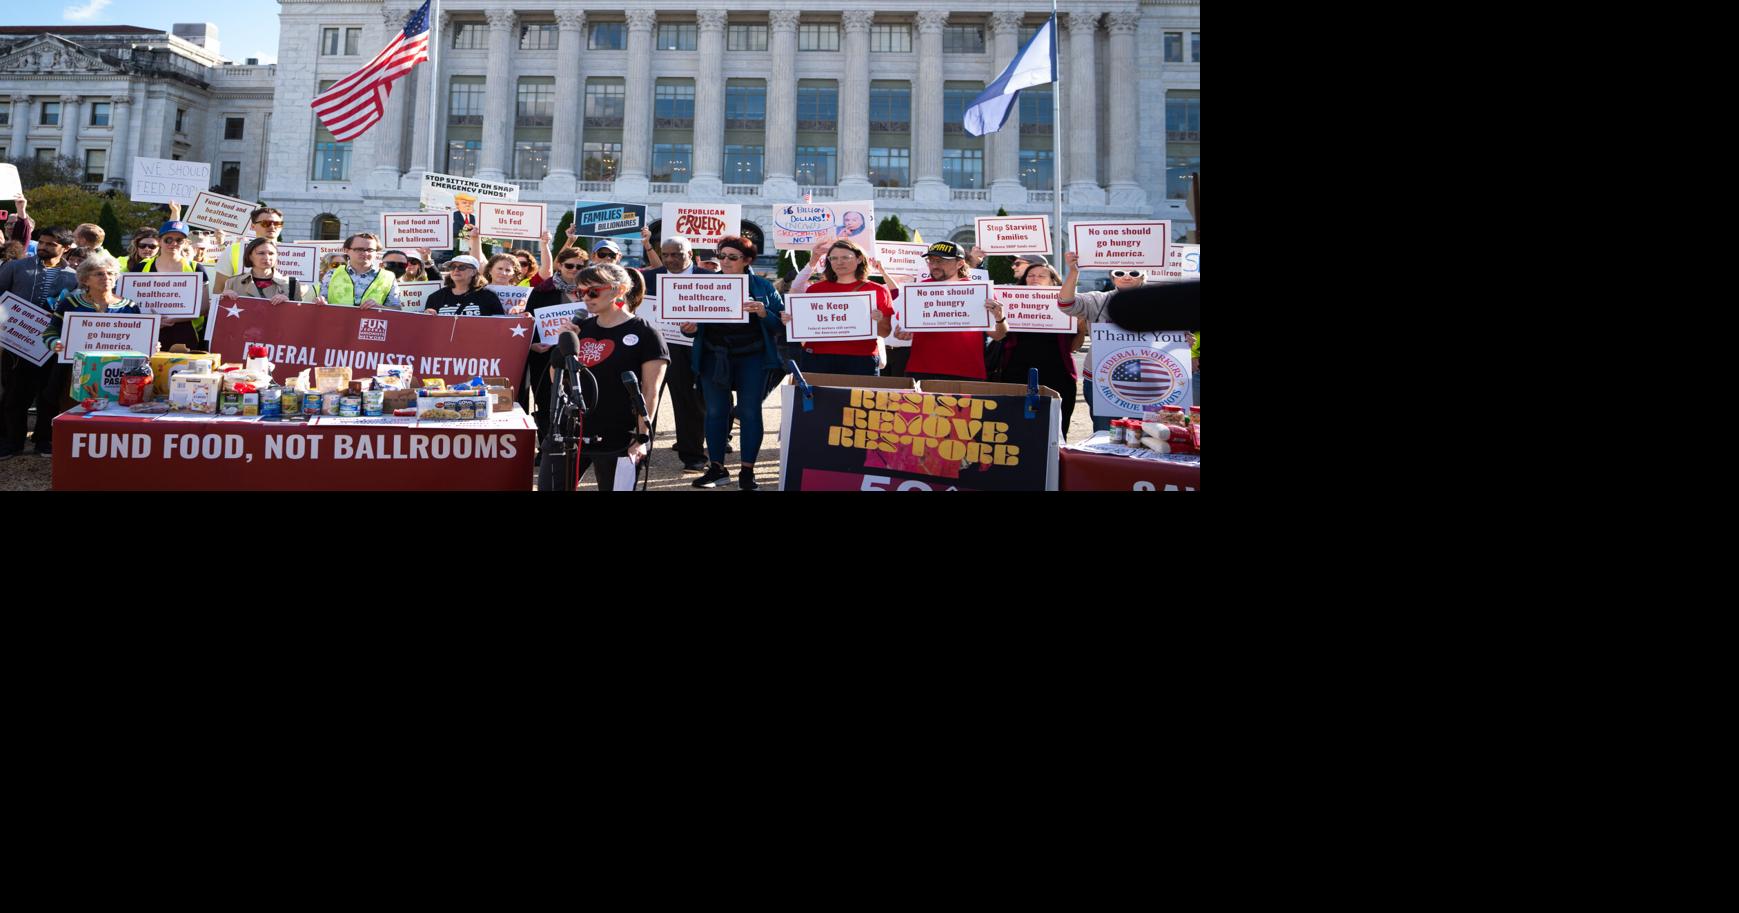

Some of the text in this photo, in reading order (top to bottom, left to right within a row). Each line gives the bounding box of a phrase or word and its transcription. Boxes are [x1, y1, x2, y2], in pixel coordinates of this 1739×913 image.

[141, 161, 209, 177] WE SHOULD
[136, 181, 165, 193] FEED
[446, 178, 479, 187] SITTING
[431, 182, 506, 197] EMERGENCY FUNDS!
[507, 209, 524, 217] Keep
[584, 209, 622, 223] FAMILIES
[598, 220, 636, 230] BILLIONAIRES
[676, 215, 725, 233] CRUELTY
[1110, 239, 1141, 247] hungry
[11, 304, 22, 312] No
[22, 311, 35, 319] one
[827, 302, 848, 310] Keep
[1021, 302, 1049, 310] hungry
[818, 314, 828, 322] Us
[1018, 312, 1053, 320] America.
[18, 320, 41, 336] hungry
[361, 320, 386, 329] FUN
[101, 331, 130, 340] hungry
[1094, 330, 1187, 343] Thank You!
[96, 342, 133, 350] America.
[420, 357, 501, 376] NETWORK
[1100, 349, 1184, 378] FEDERAL WORKERS
[850, 389, 998, 420] RESIST
[1101, 385, 1115, 400] ARE
[1114, 399, 1140, 411] TRUE
[842, 407, 1009, 443] REMOVE
[72, 432, 517, 463] FUND FOOD, NOT BALLROOMS
[828, 426, 1020, 466] RESTORE
